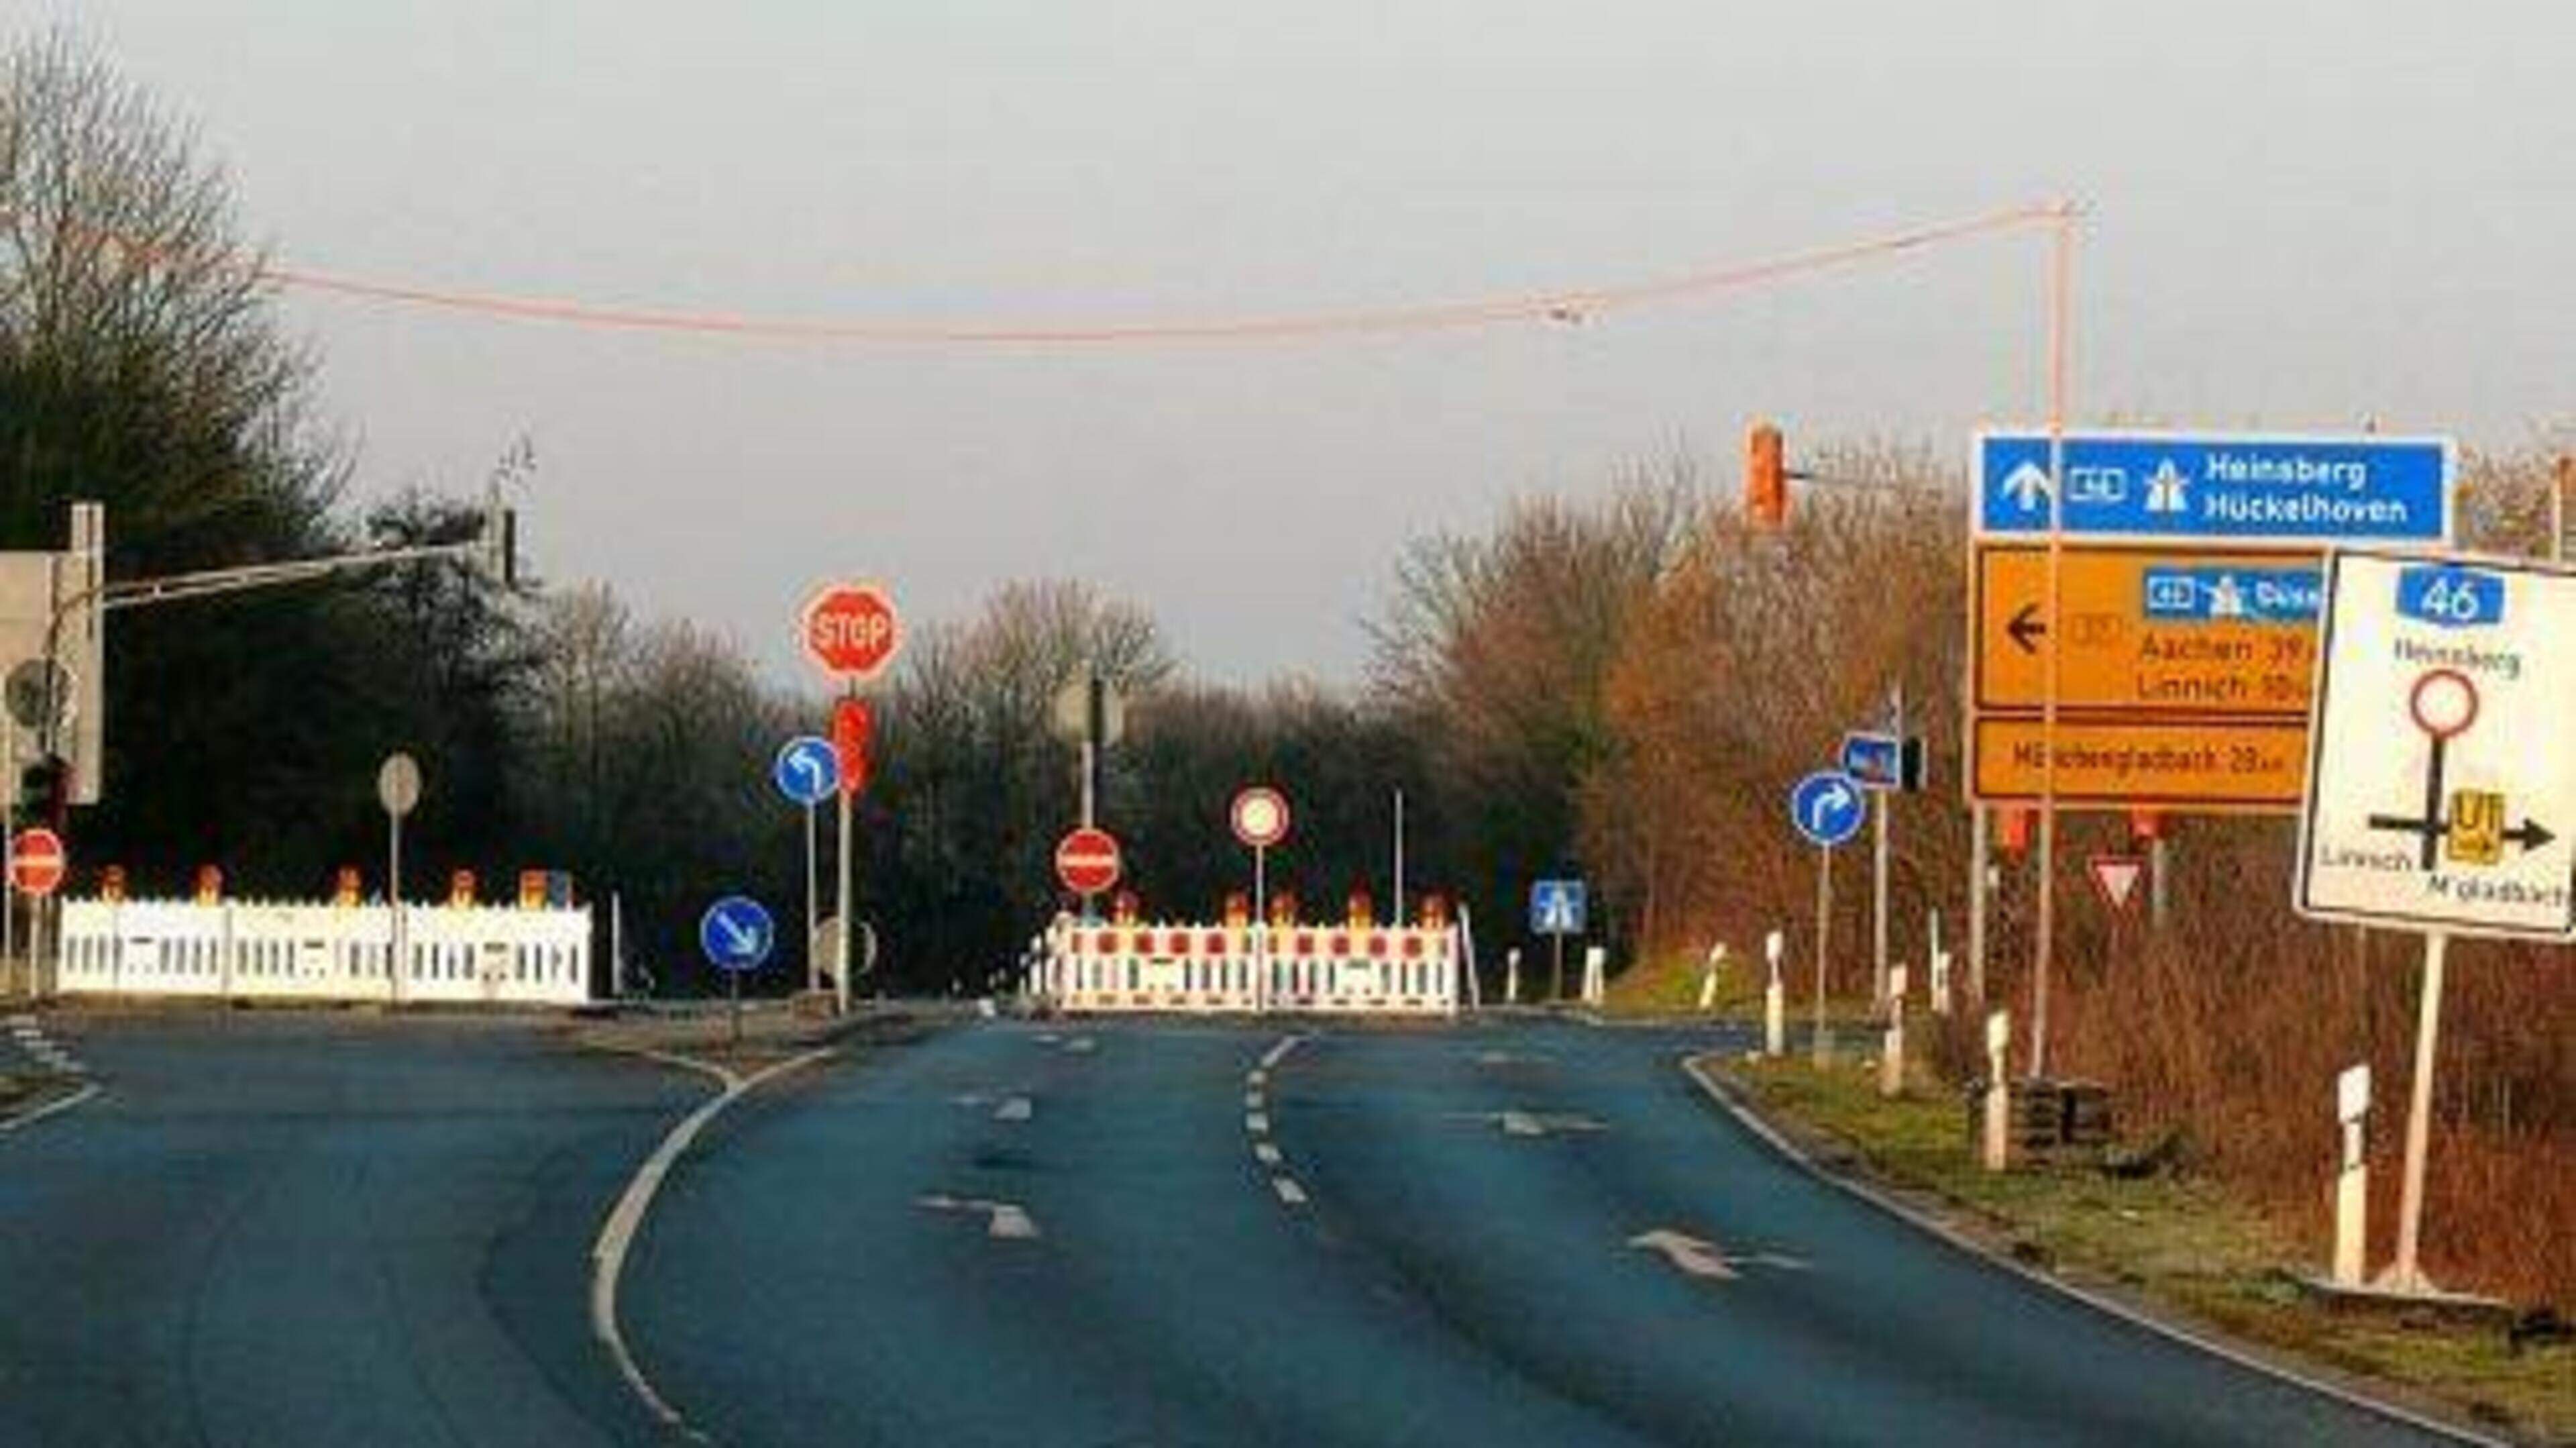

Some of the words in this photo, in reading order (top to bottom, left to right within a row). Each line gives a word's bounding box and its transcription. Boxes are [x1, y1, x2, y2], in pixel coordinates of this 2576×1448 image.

[2206, 453, 2367, 488] Heinsberg
[2205, 492, 2408, 523] Hückelhoven
[2421, 576, 2481, 618] 46
[816, 611, 888, 650] STOP
[2143, 633, 2252, 660] Aachen
